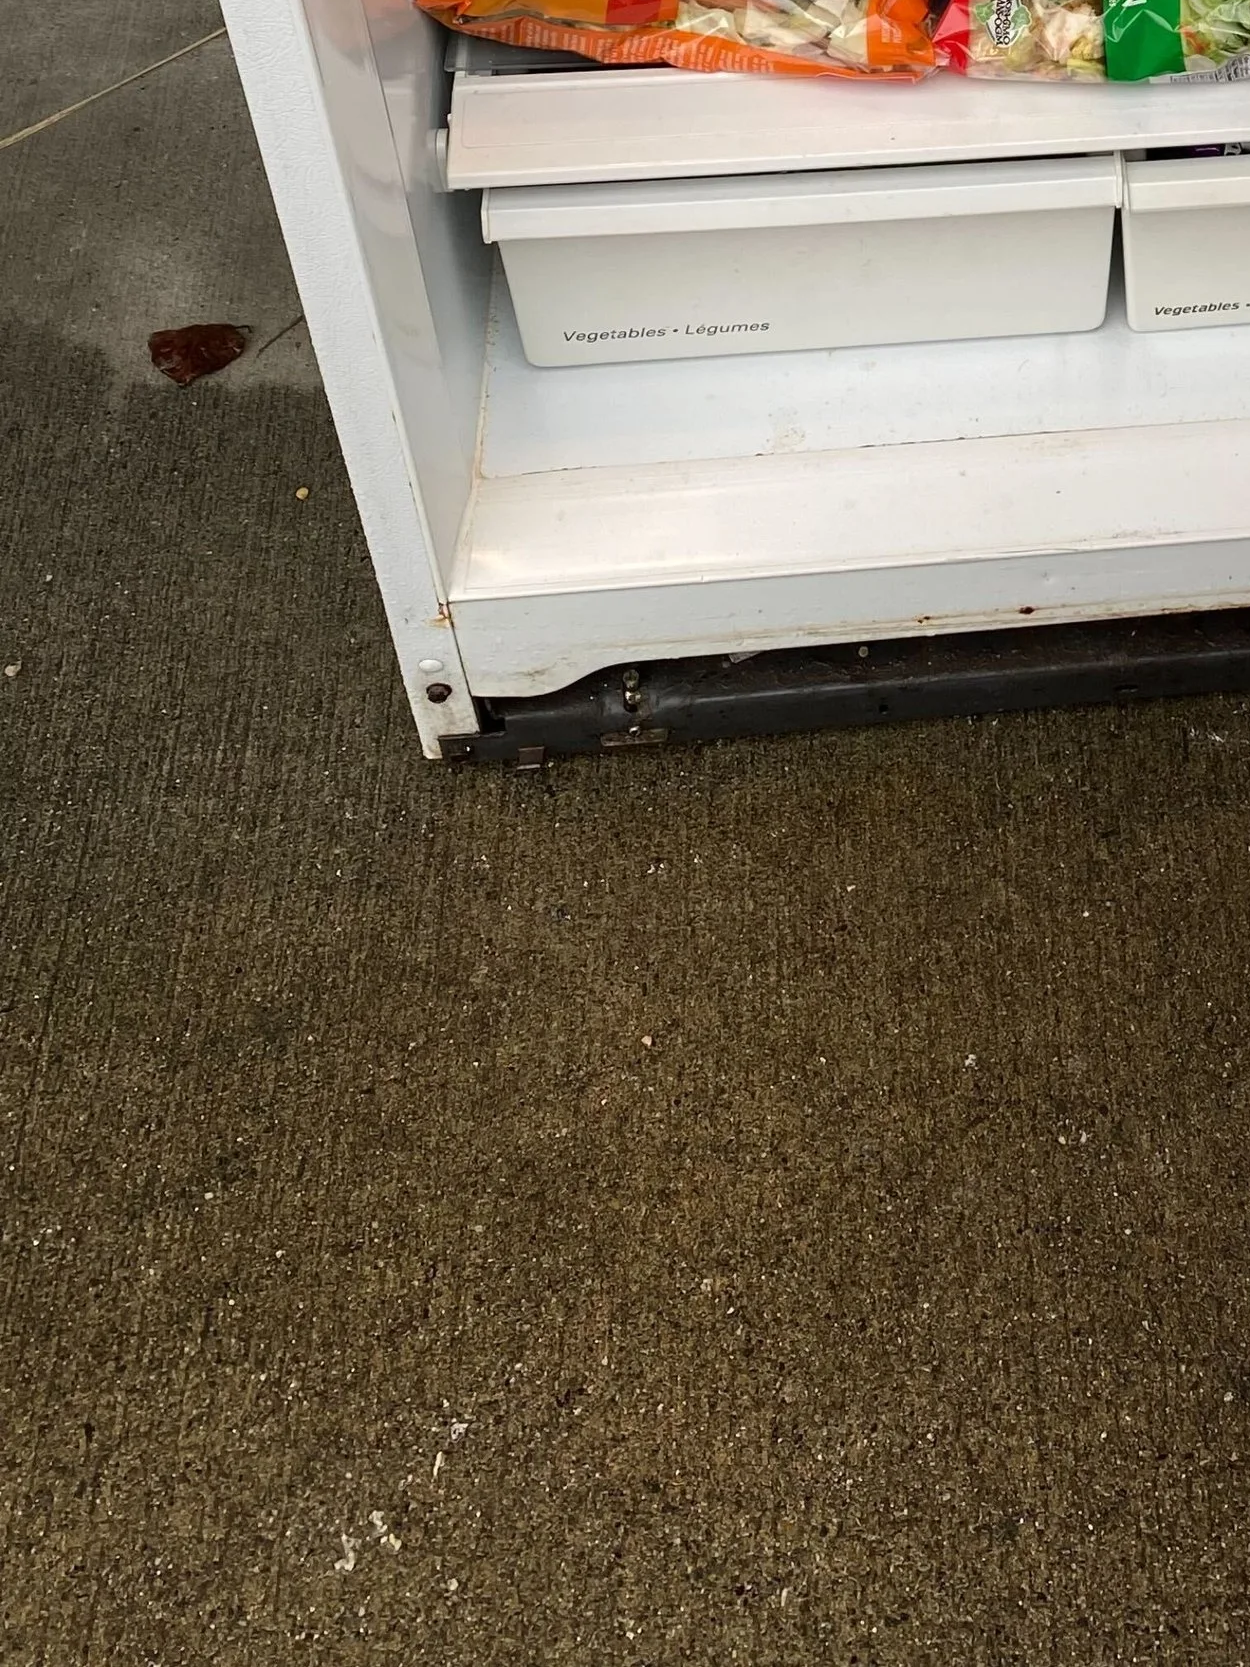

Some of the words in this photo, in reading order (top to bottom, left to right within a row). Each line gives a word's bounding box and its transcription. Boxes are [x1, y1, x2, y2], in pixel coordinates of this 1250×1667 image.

[1154, 302, 1240, 316] Vegetables
[563, 327, 666, 343] Vegetables
[685, 322, 770, 336] Légumes
